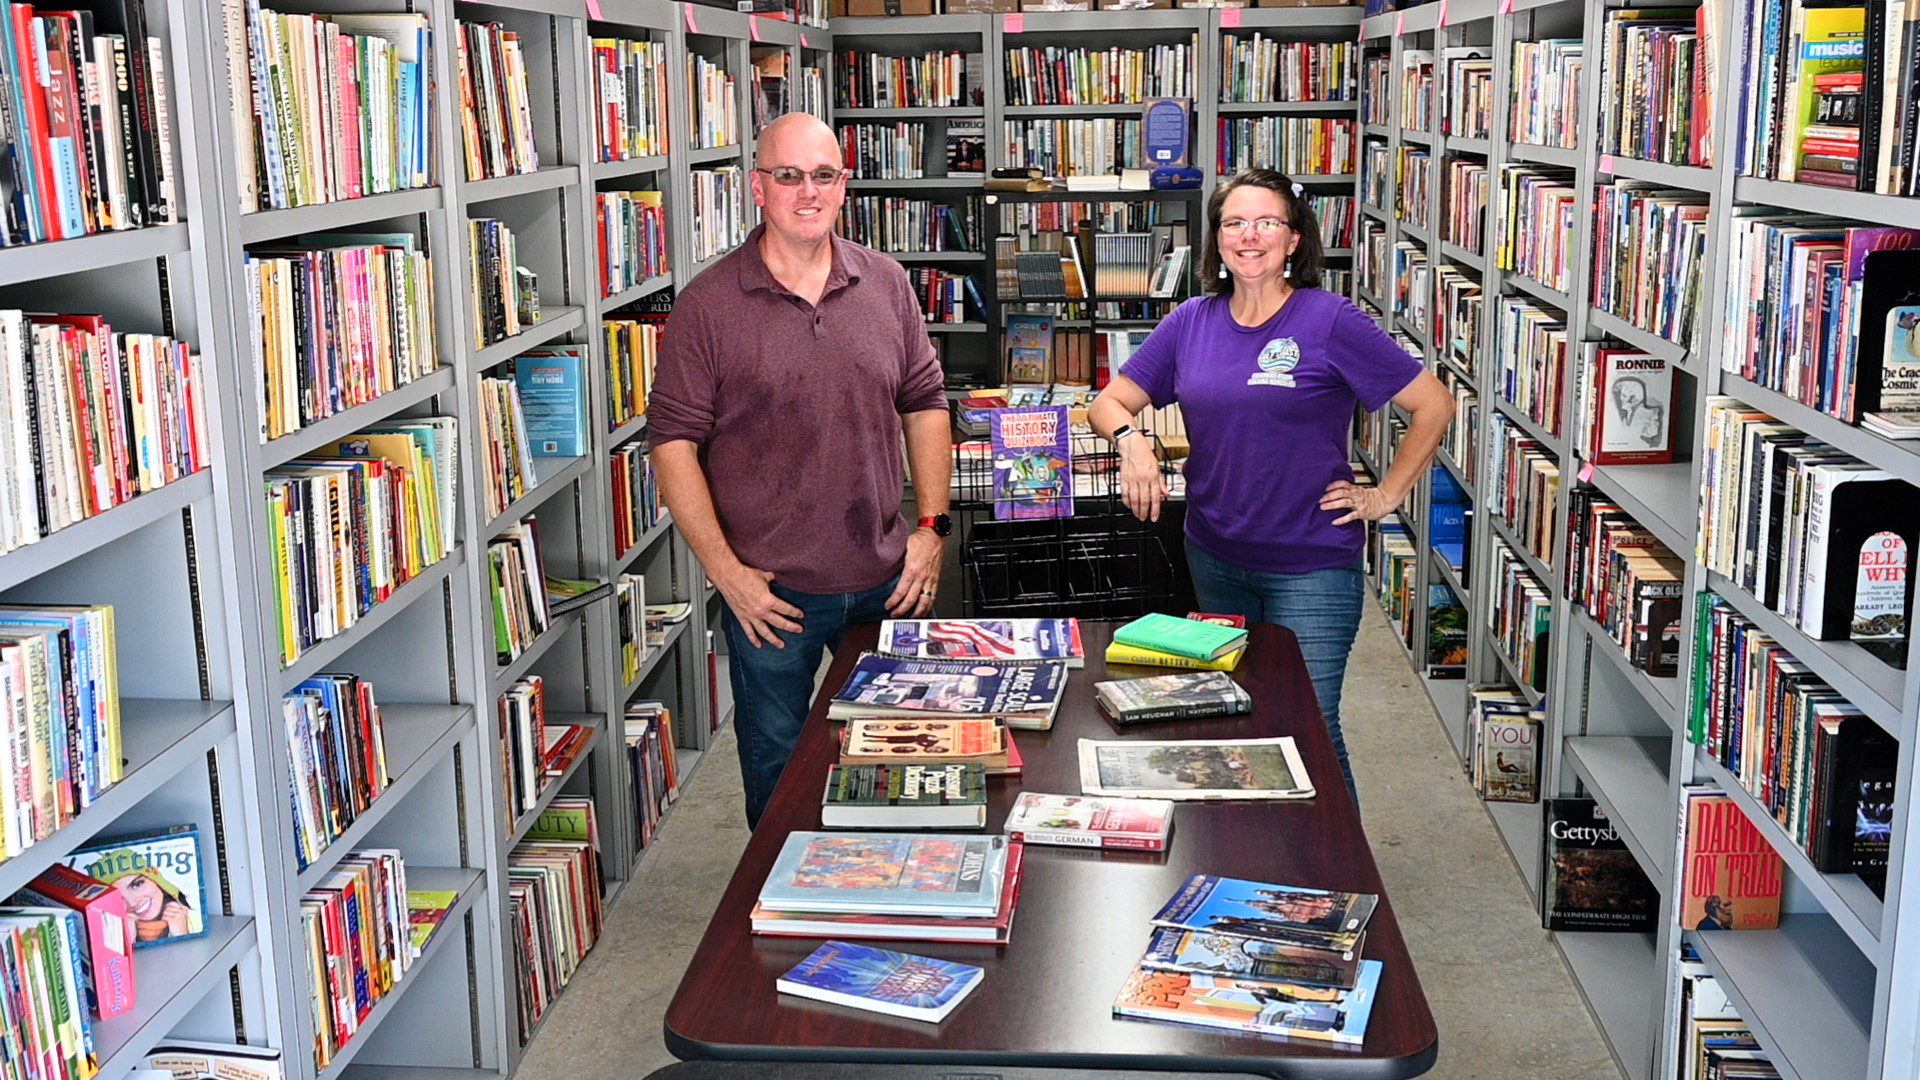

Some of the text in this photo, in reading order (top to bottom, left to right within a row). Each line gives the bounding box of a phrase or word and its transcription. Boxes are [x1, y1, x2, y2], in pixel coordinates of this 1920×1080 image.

[1809, 41, 1864, 56] music
[50, 64, 65, 124] Jazz
[121, 104, 136, 179] REBECCA WEST
[1616, 359, 1666, 370] RONNIE
[1002, 422, 1056, 436] HISTORY
[1613, 535, 1648, 545] POLICE
[1882, 538, 1902, 549] OF
[352, 528, 361, 585] COOKIES
[1860, 551, 1898, 566] ELL
[1640, 585, 1663, 597] JACK
[1490, 726, 1532, 745] YOU
[10, 738, 18, 775] GEORGE
[13, 778, 21, 810] CARLIN
[1487, 787, 1531, 798] Judi James
[1055, 836, 1094, 845] GERMAN
[1551, 820, 1621, 846] Gettysb
[70, 847, 194, 877] nitting
[1691, 855, 1781, 898] ON TRIAL
[1563, 911, 1611, 920] CONFEDERATE
